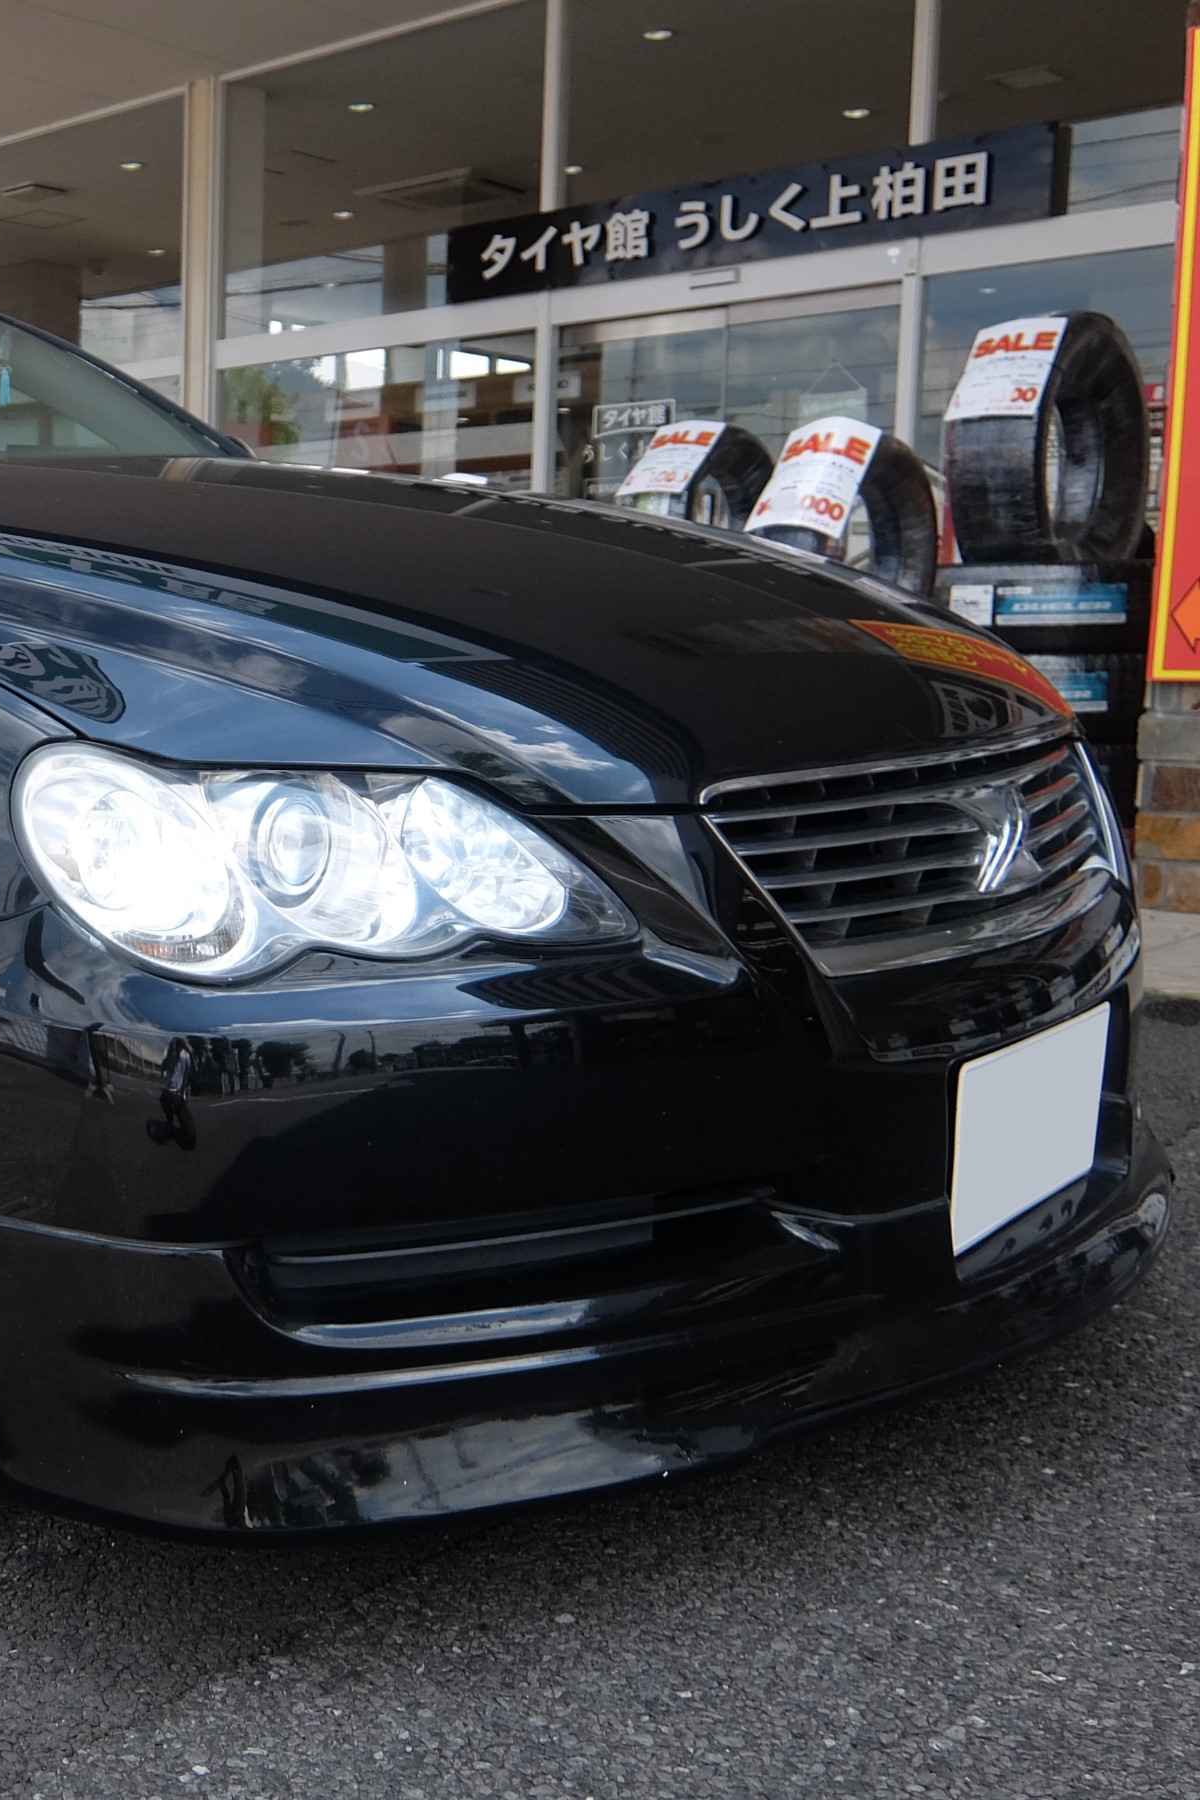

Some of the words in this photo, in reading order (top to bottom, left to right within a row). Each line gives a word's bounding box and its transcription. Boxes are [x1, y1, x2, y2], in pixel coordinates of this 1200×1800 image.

[481, 207, 650, 280] タイヤ館
[674, 151, 989, 251] うしく上柏田
[973, 331, 1059, 359] SALE
[602, 404, 667, 429] タイヤ館
[651, 430, 717, 450] SALE
[781, 431, 873, 466] SALE
